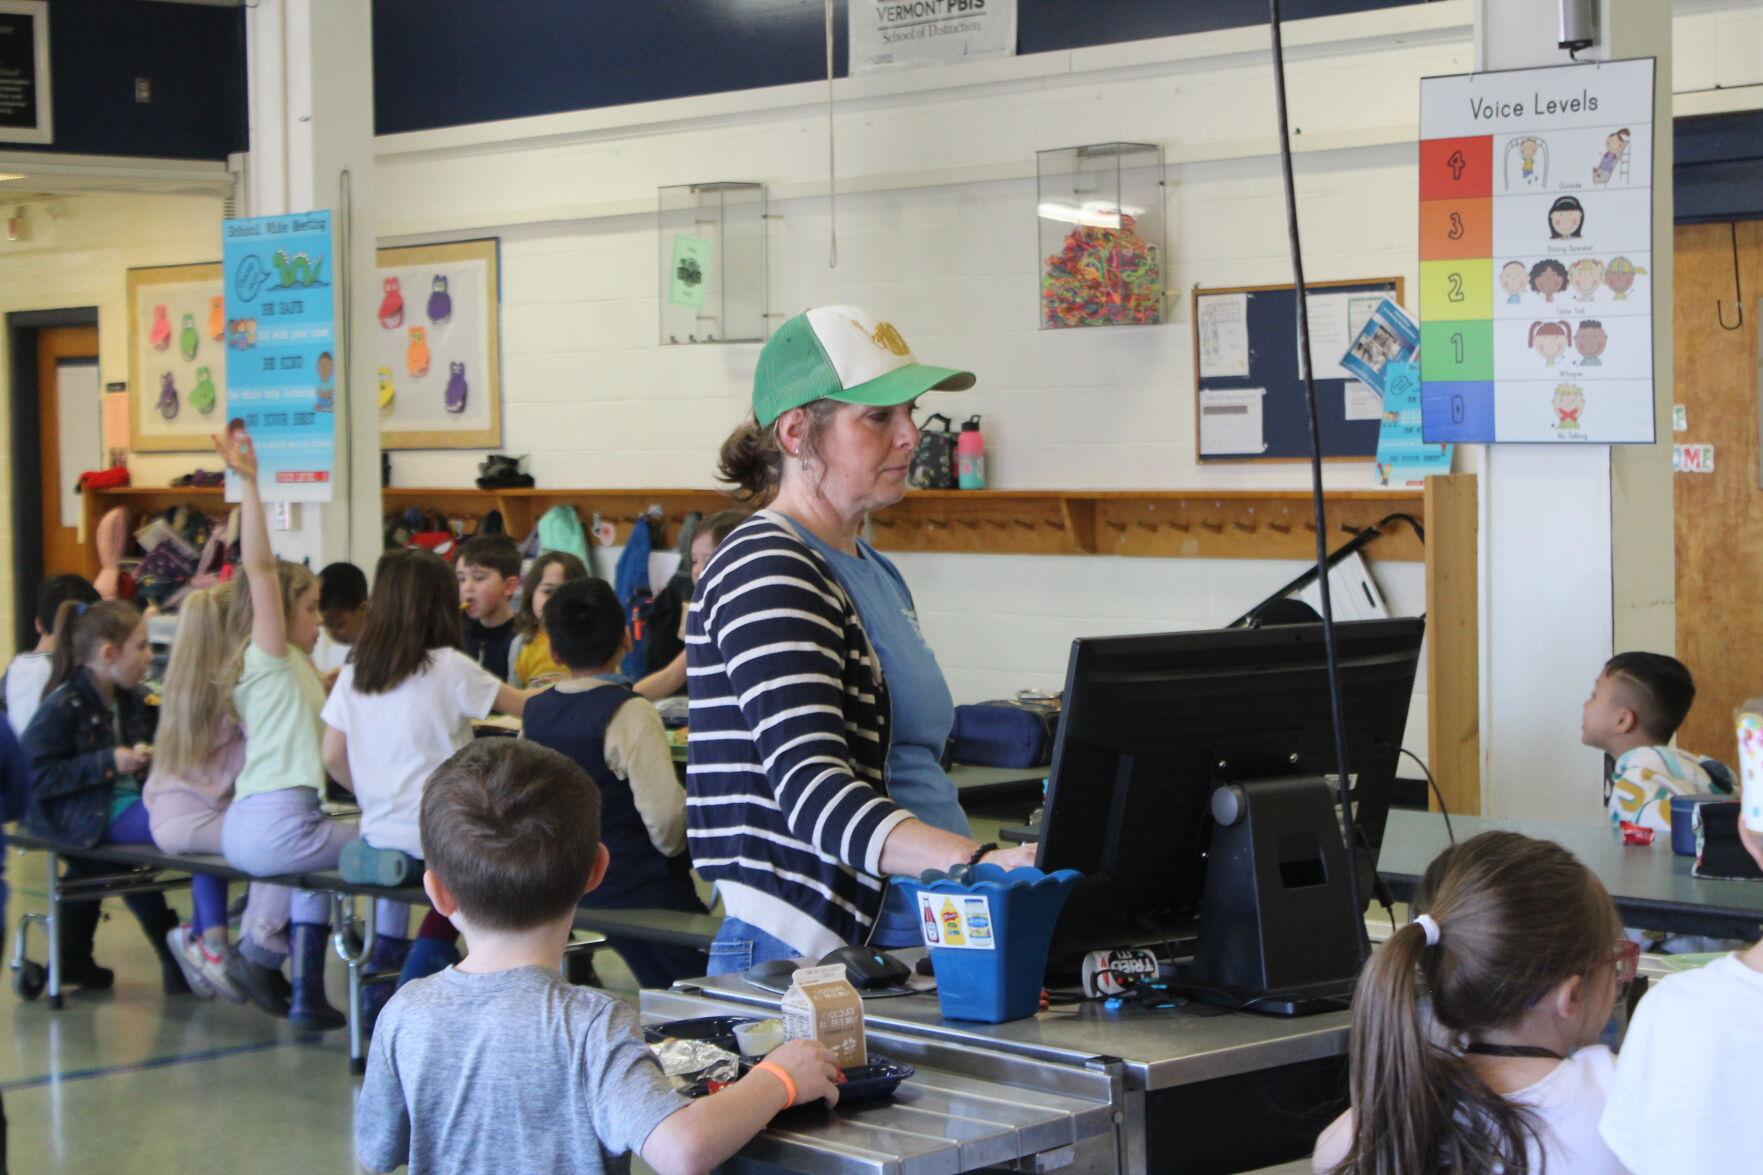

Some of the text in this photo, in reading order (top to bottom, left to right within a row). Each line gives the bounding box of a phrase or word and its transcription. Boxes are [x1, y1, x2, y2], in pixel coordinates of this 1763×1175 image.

[877, 0, 986, 22] VERMONT PBIS
[883, 21, 982, 44] School of Distinction
[1470, 88, 1599, 120] Voice Levels
[1447, 151, 1466, 180] 4
[228, 218, 327, 237] School Wide Meeting
[1448, 212, 1464, 240] 3
[1448, 273, 1465, 303] 2
[261, 300, 304, 316] BE SAFE
[1450, 332, 1464, 364] 1
[279, 355, 304, 370] KIND
[263, 412, 288, 427] YOUR
[293, 411, 316, 426] BEST
[1451, 394, 1465, 424] 0
[1111, 958, 1155, 974] TRIED
